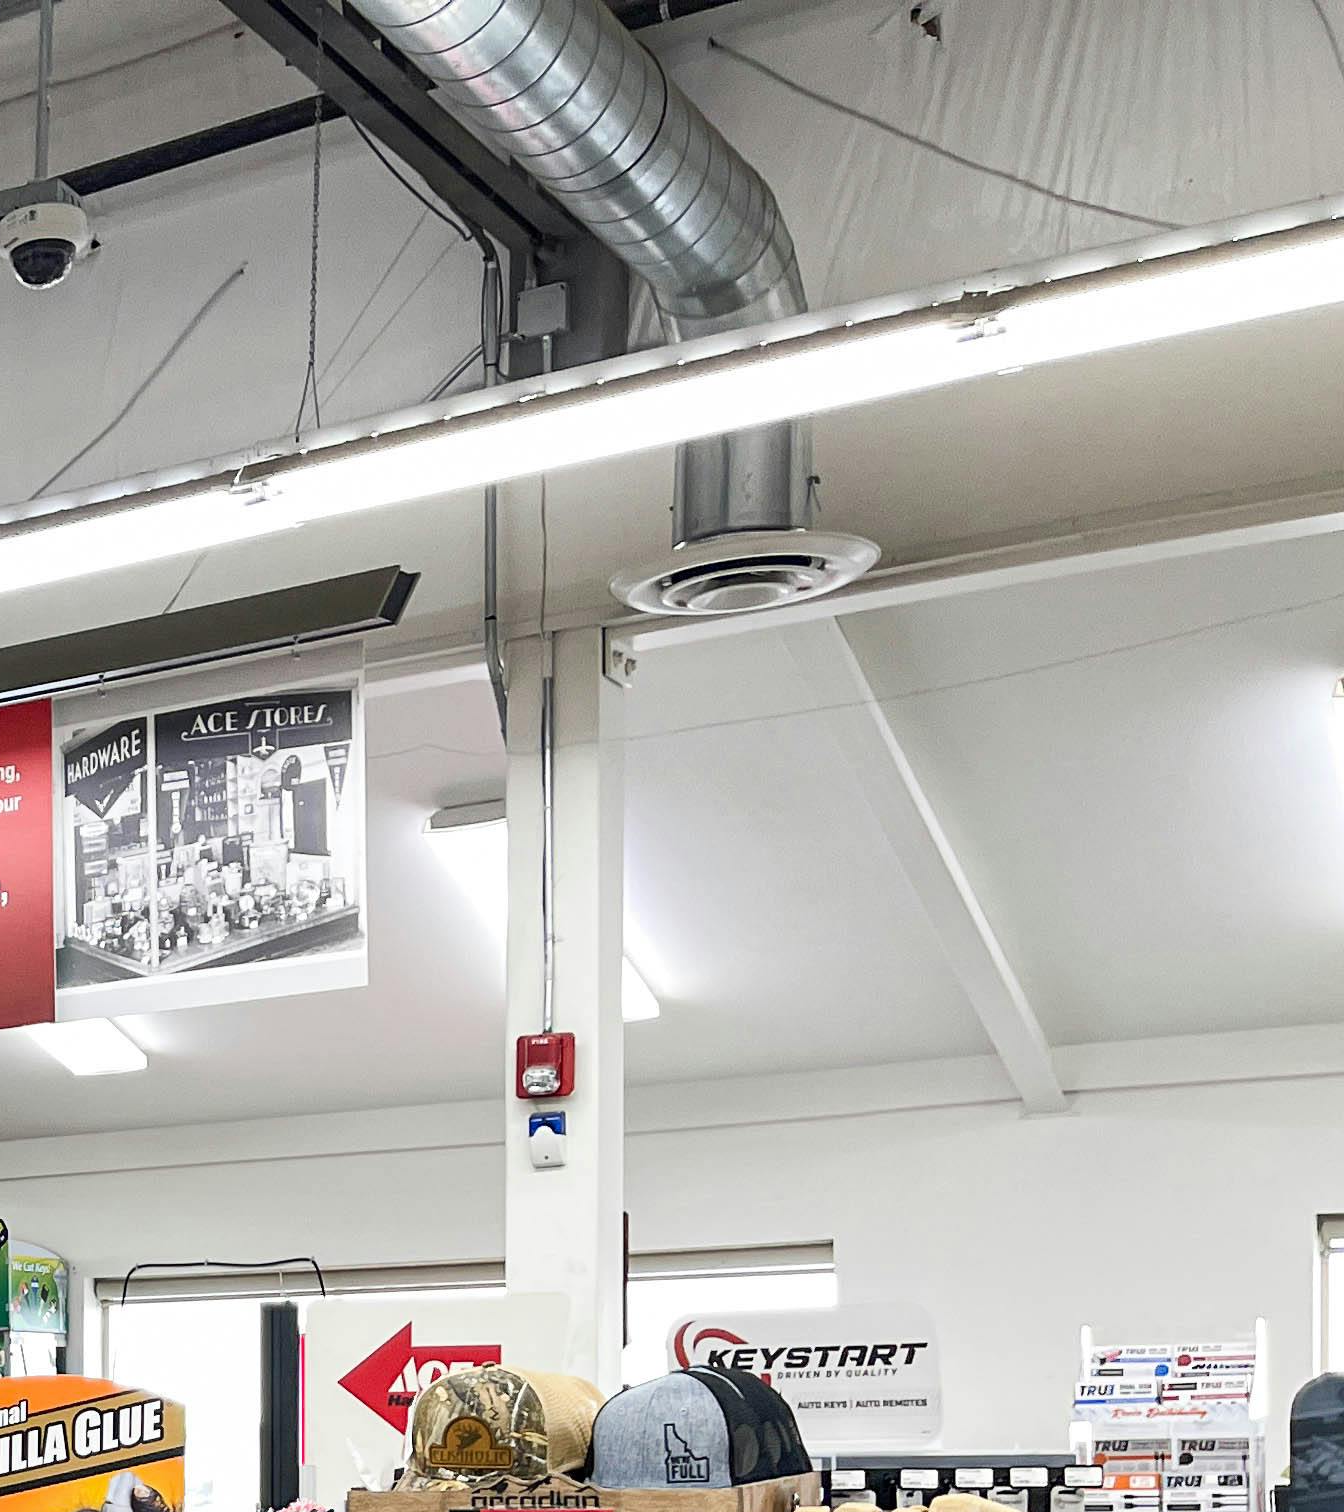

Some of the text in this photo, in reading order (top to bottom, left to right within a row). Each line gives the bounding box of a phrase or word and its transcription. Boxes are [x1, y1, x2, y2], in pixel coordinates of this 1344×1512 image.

[191, 703, 326, 735] ACE STORES
[66, 728, 142, 785] HARDWARE
[707, 1342, 929, 1370] KEYSTART
[777, 1367, 899, 1380] DRIVEN BY QUALITY
[797, 1398, 929, 1409] AUTO KEYS AUTO REMOTES
[74, 1398, 164, 1457] GLUE
[671, 1464, 707, 1480] FULL
[471, 1490, 600, 1509] arcadian
